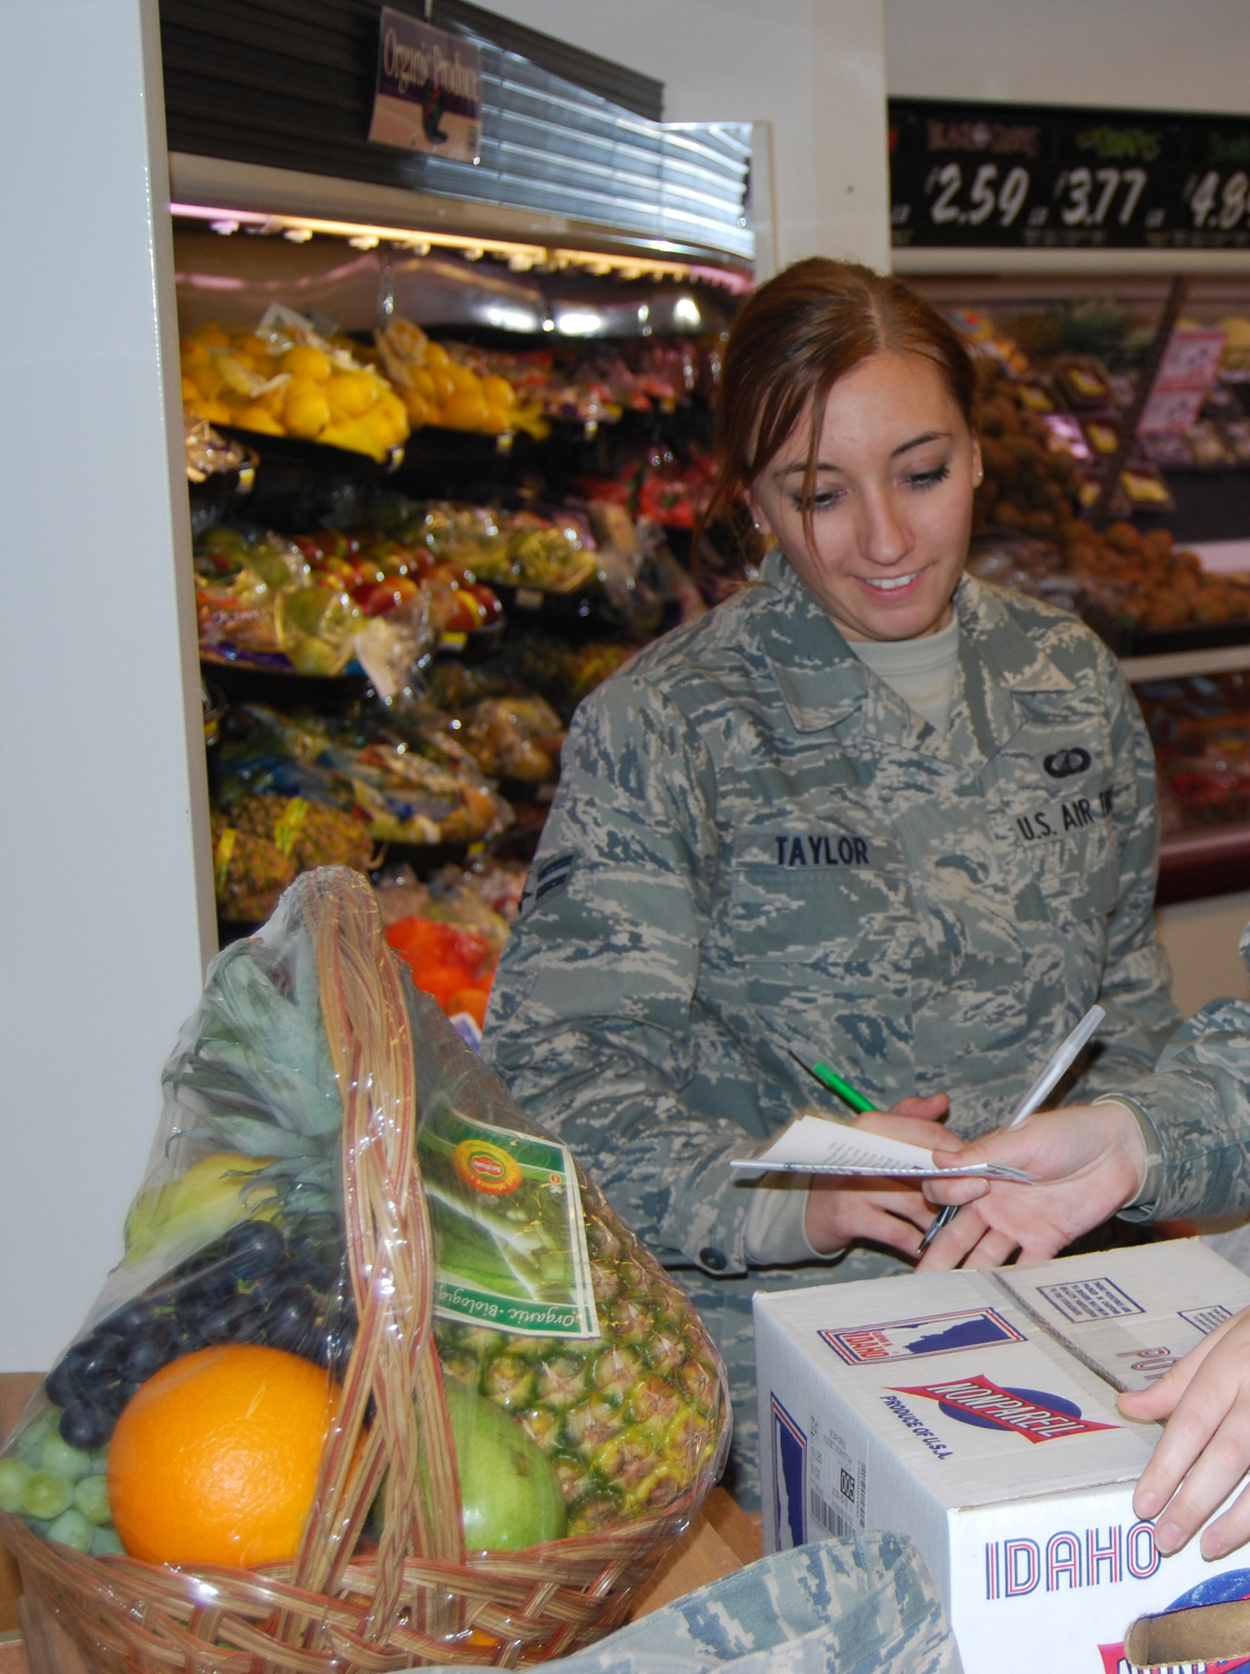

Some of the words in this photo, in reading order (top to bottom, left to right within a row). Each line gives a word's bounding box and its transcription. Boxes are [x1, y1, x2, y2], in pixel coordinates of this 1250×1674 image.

[1017, 811, 1057, 841] U.S.
[1061, 797, 1095, 832] AIR
[775, 835, 870, 867] TAYLOR
[438, 1283, 499, 1318] Biologiq
[507, 1306, 575, 1327] Organic
[842, 1332, 890, 1359] IDAHO
[879, 1395, 925, 1428] PRODUCE
[912, 1427, 935, 1437] OF
[925, 1380, 1088, 1438] NONPAREIL
[985, 1519, 1163, 1601] IDAHO
